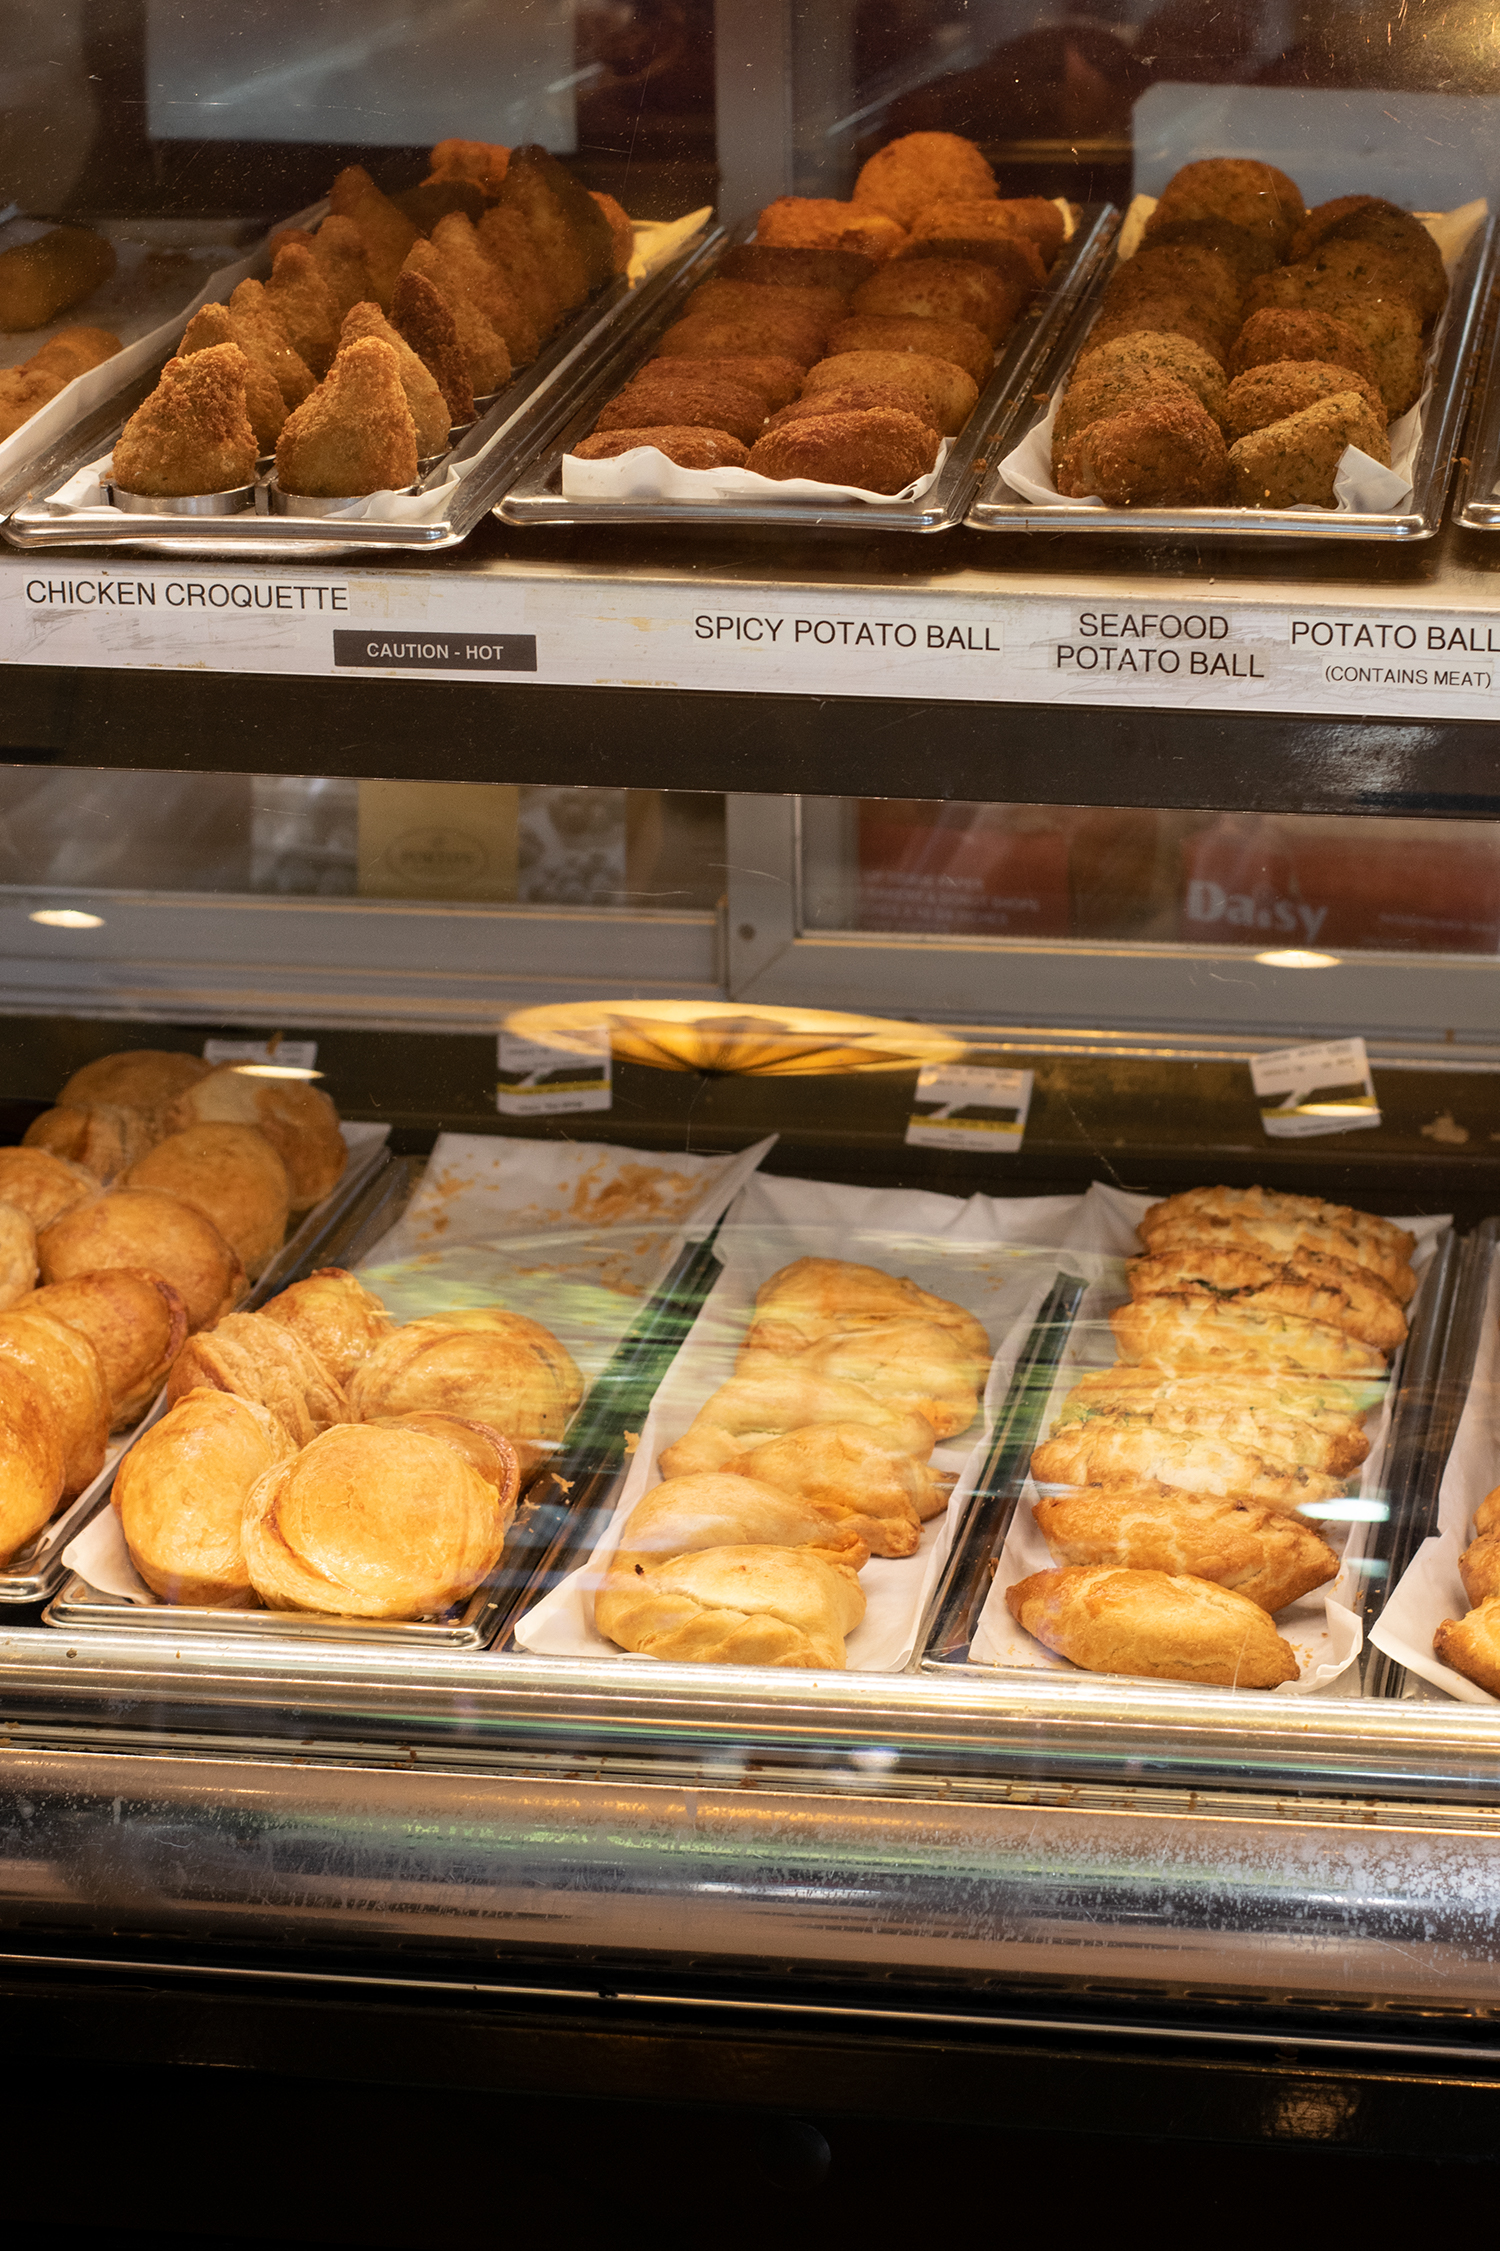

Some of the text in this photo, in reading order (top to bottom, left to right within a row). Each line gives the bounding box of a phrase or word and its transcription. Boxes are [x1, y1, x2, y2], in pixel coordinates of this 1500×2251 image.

[26, 580, 348, 611] CHICKEN CROQUETTE
[695, 615, 1001, 651] SPICY POTATO BALL
[1079, 612, 1229, 640] SEAFOOD
[1292, 621, 1500, 652] POTATO BALL
[366, 642, 449, 659] CAUTION
[466, 645, 504, 660] HOT
[1057, 644, 1265, 678] POTATO BALL
[1325, 665, 1491, 689] (CONTAINS MEAT)
